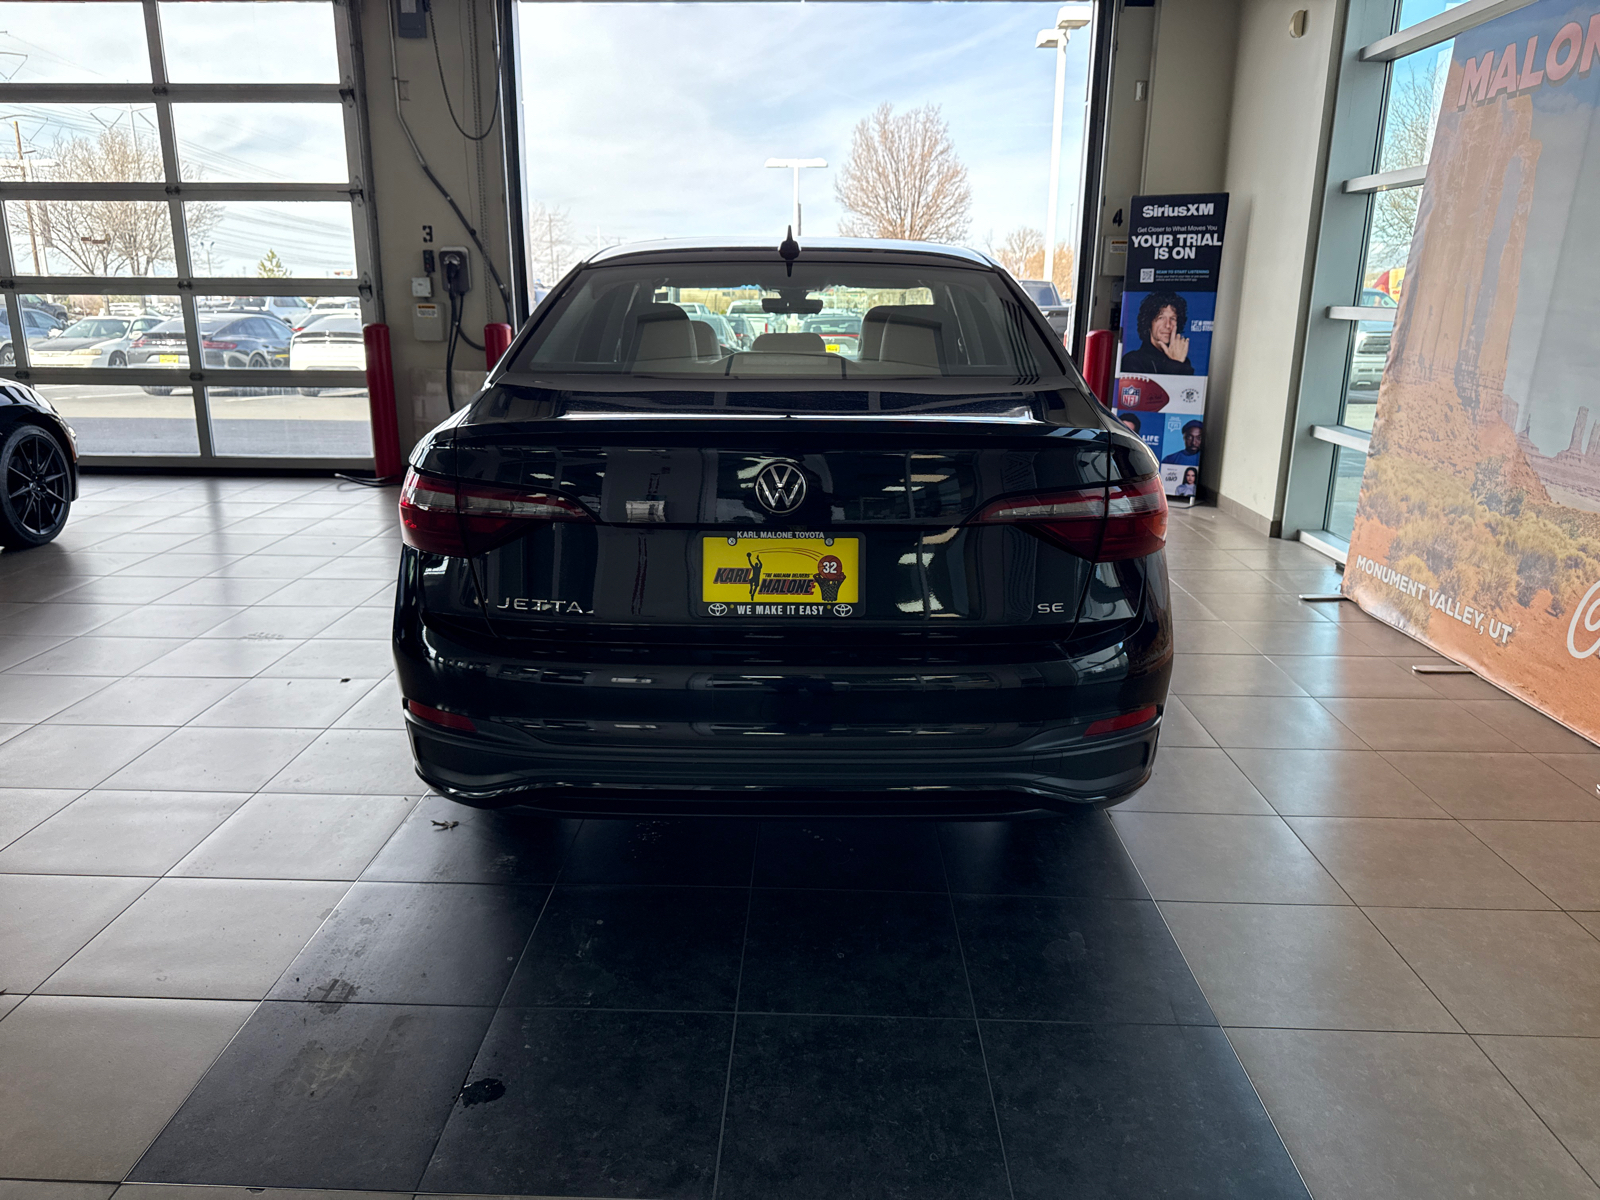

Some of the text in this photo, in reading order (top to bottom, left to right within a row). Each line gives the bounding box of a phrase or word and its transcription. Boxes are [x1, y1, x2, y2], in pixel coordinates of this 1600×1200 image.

[1112, 208, 1123, 227] 4
[1142, 203, 1214, 218] SiriusXM
[422, 225, 433, 243] 3
[1131, 234, 1173, 248] YOUR
[1176, 233, 1222, 246] TRIAL
[1154, 246, 1196, 260] IS ON
[1122, 395, 1139, 405] NFL
[736, 531, 825, 539] KARL MALONE TOYOTA
[822, 561, 838, 574] 32
[713, 567, 753, 584] KARL
[758, 578, 816, 595] MALONE
[496, 597, 583, 614] JETTA
[1355, 554, 1427, 601] MONUMENT
[1428, 588, 1485, 635] VALLEY,
[1488, 618, 1513, 644] UT
[737, 605, 824, 615] WE MAKE IT EASY
[1037, 602, 1065, 613] SE
